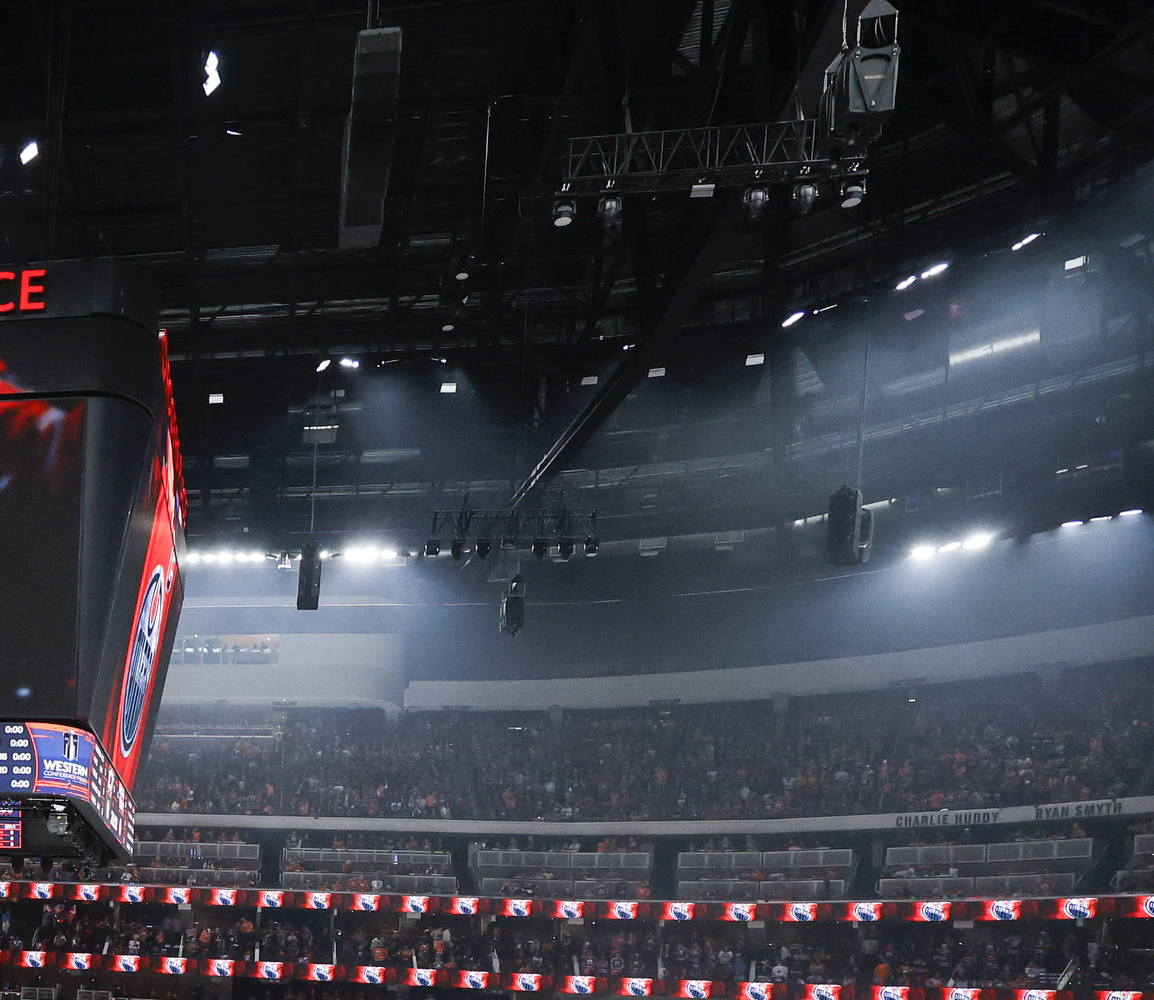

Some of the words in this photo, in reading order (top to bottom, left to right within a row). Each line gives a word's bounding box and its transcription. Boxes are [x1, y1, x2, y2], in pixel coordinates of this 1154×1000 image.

[5, 725, 23, 734] 0:00
[10, 739, 29, 747] 0:00
[12, 753, 31, 761] 0:00
[13, 766, 32, 774] 0:00
[43, 759, 88, 777] WESTERN
[11, 780, 30, 788] 0:00
[1035, 807, 1069, 820] RYAN
[1075, 802, 1122, 817] SMYTH
[896, 813, 949, 827] CHARLIE
[955, 811, 1001, 825] HUDDY
